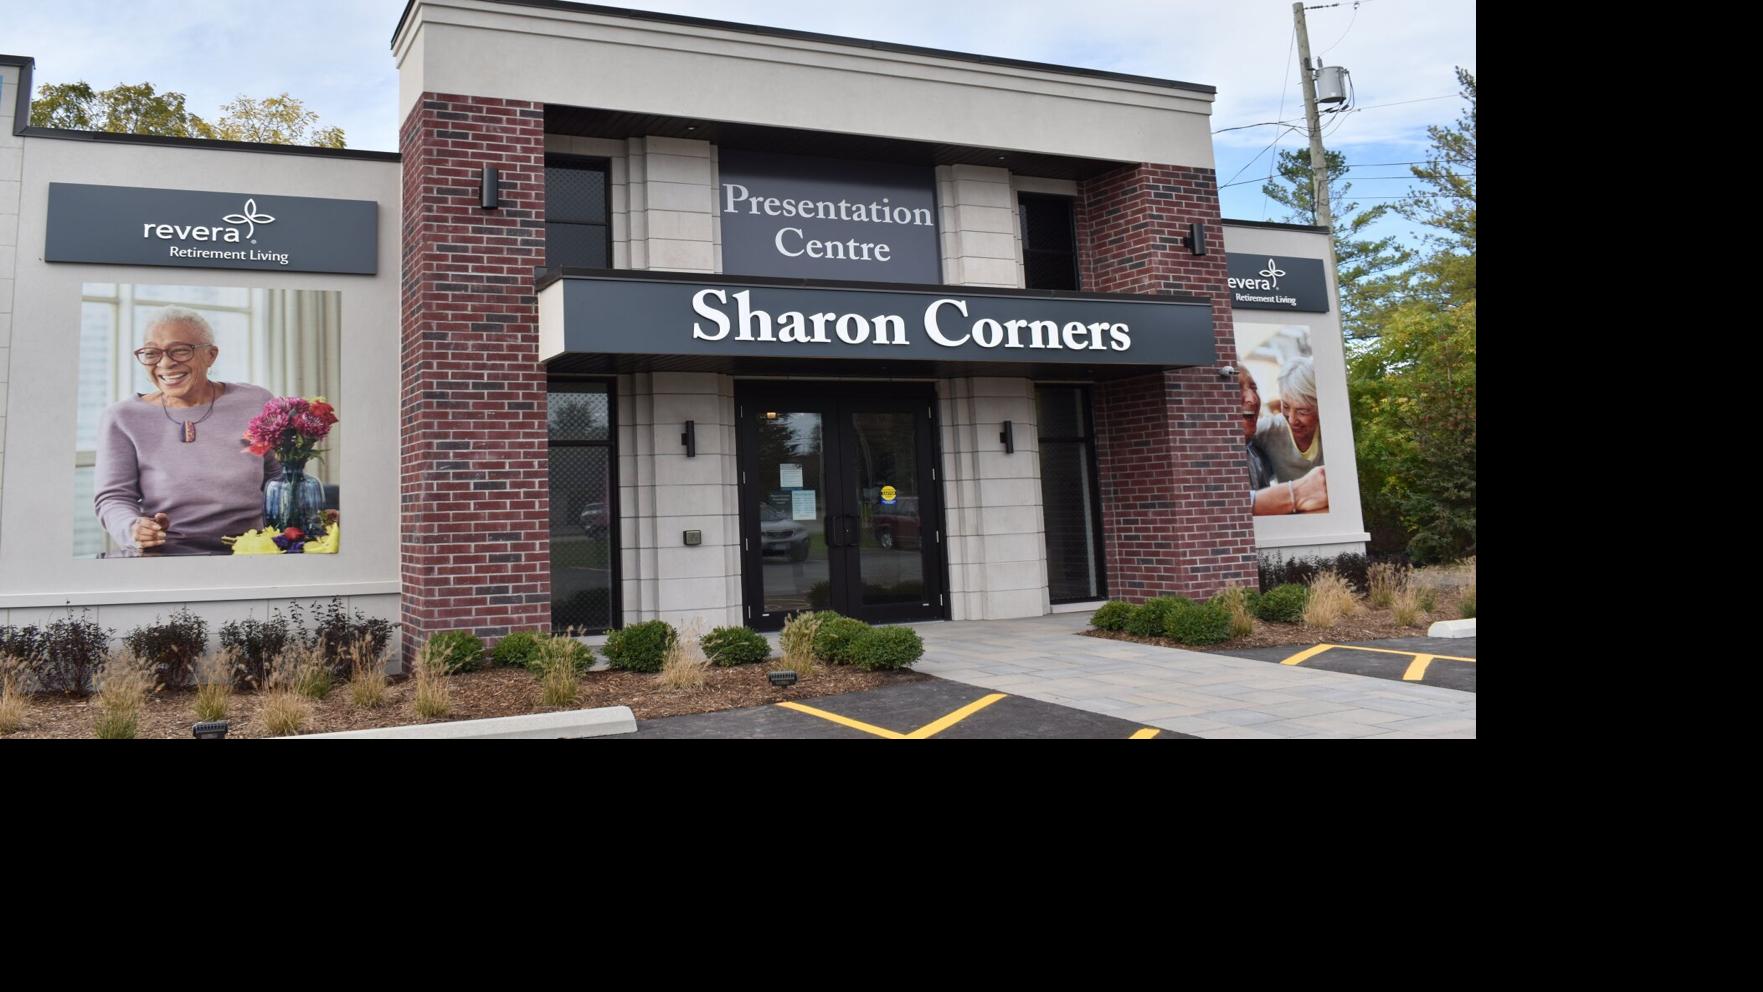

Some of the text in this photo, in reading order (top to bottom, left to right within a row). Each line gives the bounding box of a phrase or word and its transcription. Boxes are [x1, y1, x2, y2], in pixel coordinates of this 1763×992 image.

[722, 182, 934, 227] Presentation
[143, 222, 240, 243] revera
[169, 246, 289, 264] Retirement Living
[774, 227, 892, 262] Centre
[1227, 277, 1271, 291] evera
[1235, 293, 1297, 306] Retirement Living
[692, 288, 1132, 352] Sharon Corners
